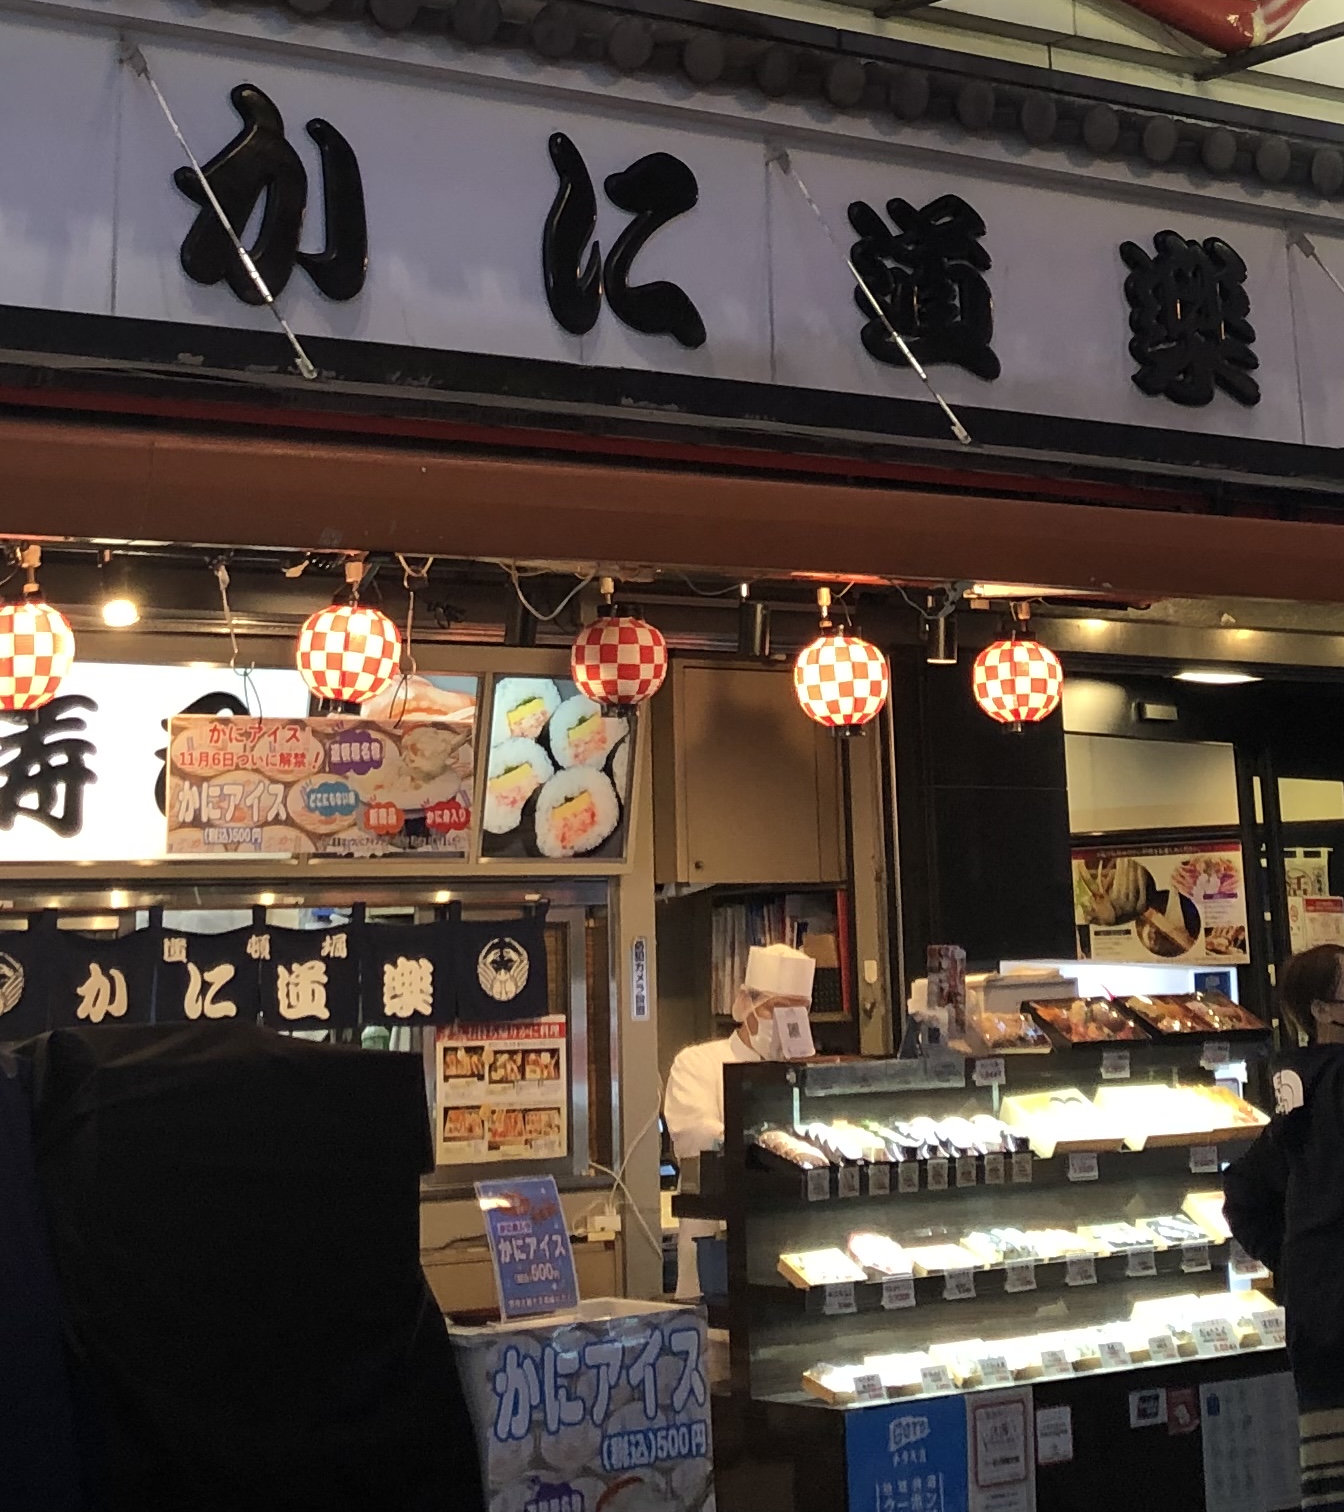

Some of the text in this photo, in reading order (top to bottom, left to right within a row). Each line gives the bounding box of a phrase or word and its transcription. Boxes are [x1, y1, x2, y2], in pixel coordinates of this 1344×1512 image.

[208, 723, 301, 745] かにアイス
[177, 781, 287, 823] かにアイス
[498, 1234, 567, 1264] かにアイス
[493, 1327, 708, 1443] かにアイス
